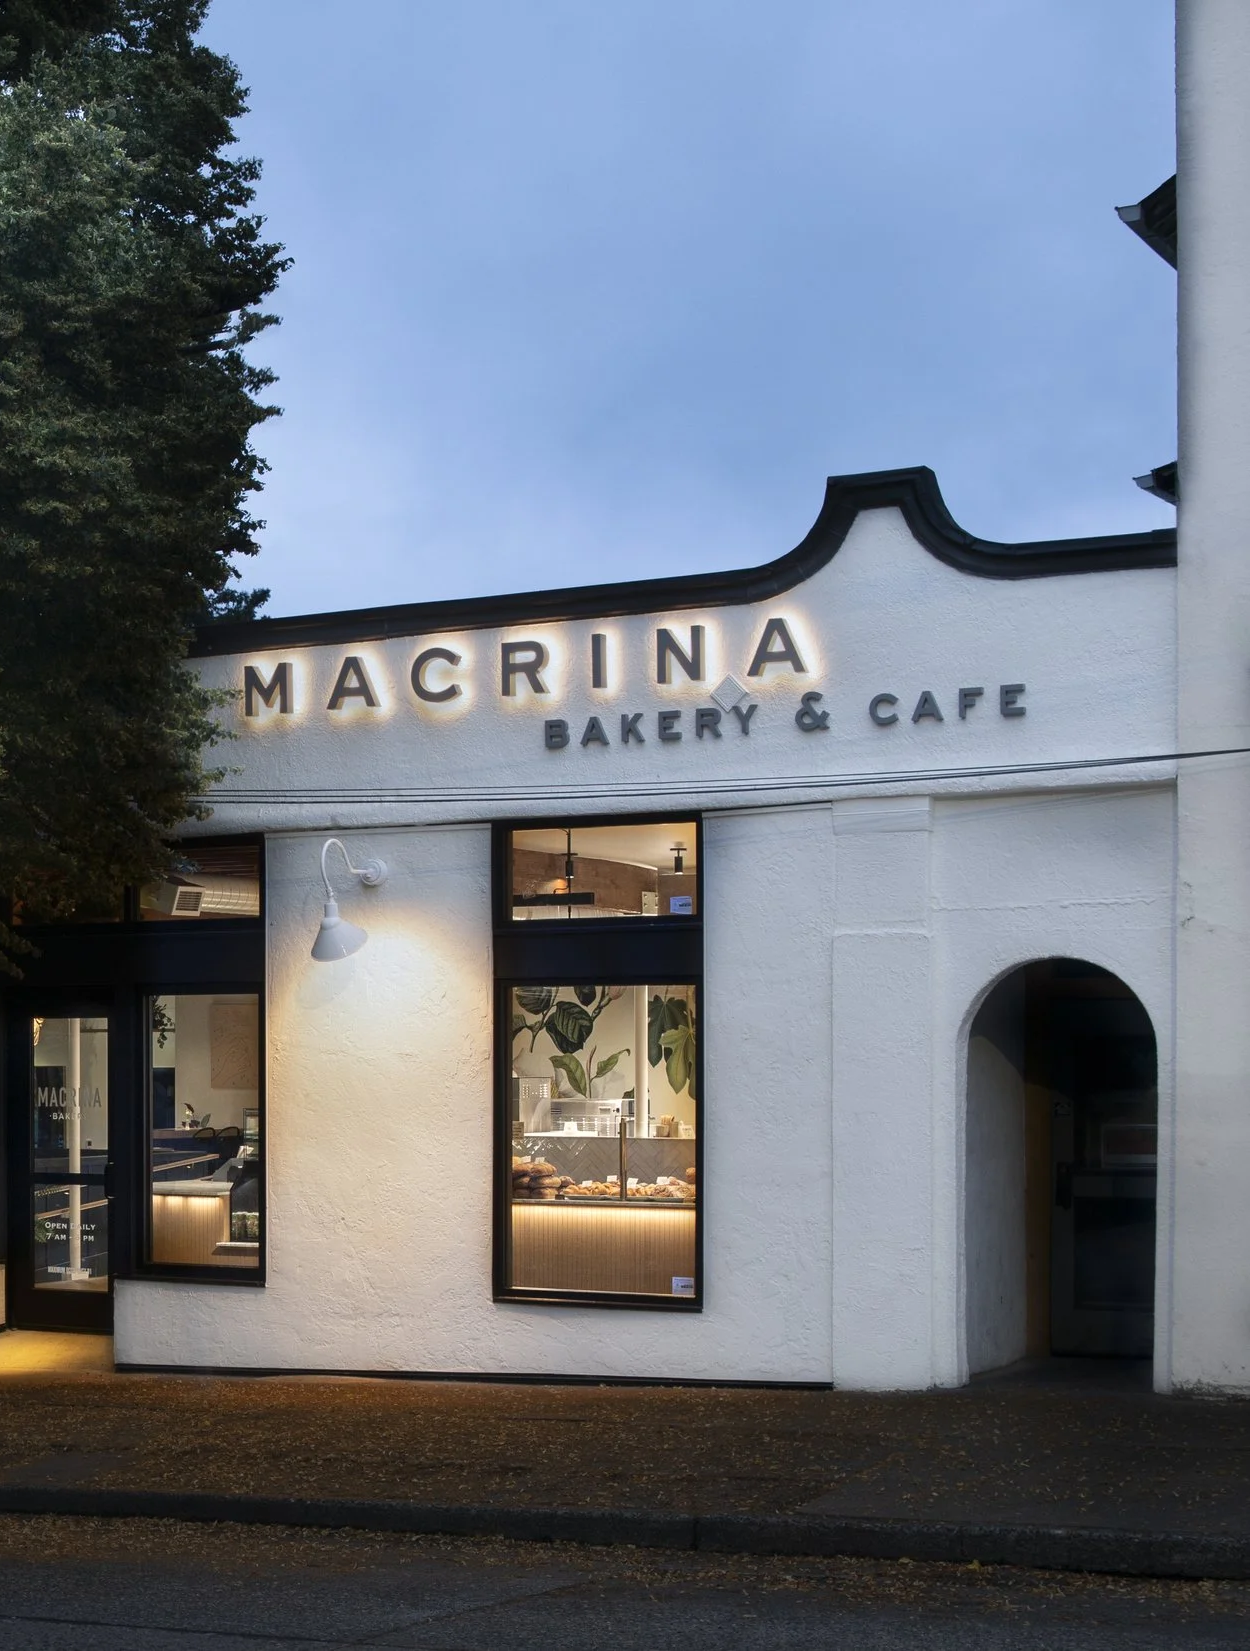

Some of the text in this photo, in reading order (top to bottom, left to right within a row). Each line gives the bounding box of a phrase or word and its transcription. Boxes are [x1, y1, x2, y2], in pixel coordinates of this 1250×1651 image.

[244, 618, 809, 717] MACRINA
[545, 684, 1027, 749] BAKERY & CAFE
